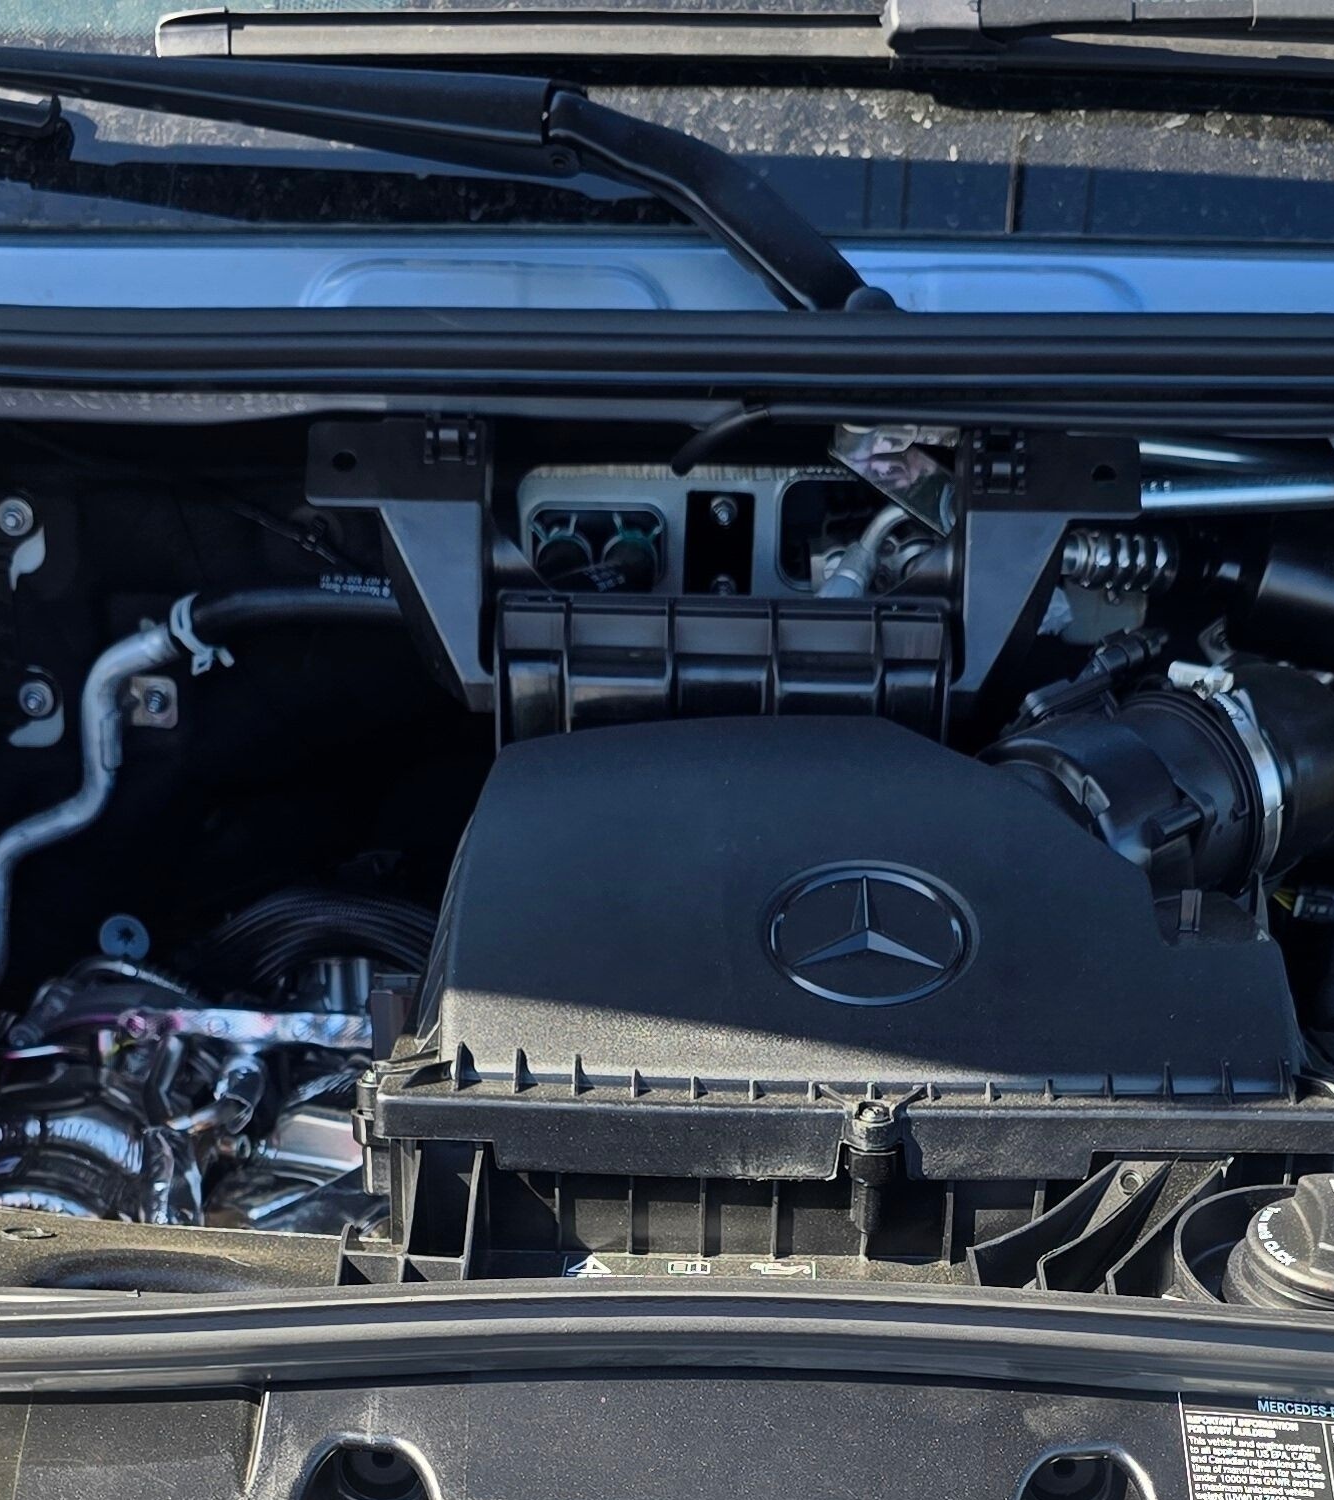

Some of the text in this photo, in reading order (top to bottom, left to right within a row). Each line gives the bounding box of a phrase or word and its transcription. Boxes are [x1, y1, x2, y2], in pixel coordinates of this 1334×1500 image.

[1263, 1240, 1297, 1266] CLICK
[1238, 1419, 1299, 1431] INFORMATION
[1188, 1436, 1206, 1445] This
[1207, 1438, 1237, 1447] vehicle
[1239, 1440, 1255, 1448] and
[1285, 1442, 1320, 1453] conform
[1213, 1448, 1254, 1458] applicable
[1256, 1451, 1269, 1459] US
[1291, 1452, 1316, 1462] CARB
[1191, 1455, 1207, 1463] and
[1209, 1455, 1248, 1465] Canadian
[1307, 1462, 1322, 1472] the
[1191, 1464, 1211, 1473] time
[1223, 1466, 1275, 1476] manufacture
[1277, 1469, 1289, 1477] for
[1291, 1470, 1326, 1480] vehicles
[1193, 1474, 1217, 1483] under
[1221, 1475, 1247, 1484] 10000
[1263, 1477, 1290, 1487] GVWR
[1292, 1479, 1308, 1488] and
[1202, 1484, 1243, 1493] maximum
[1245, 1486, 1283, 1496] unloaded
[1285, 1488, 1315, 1498] vehicle
